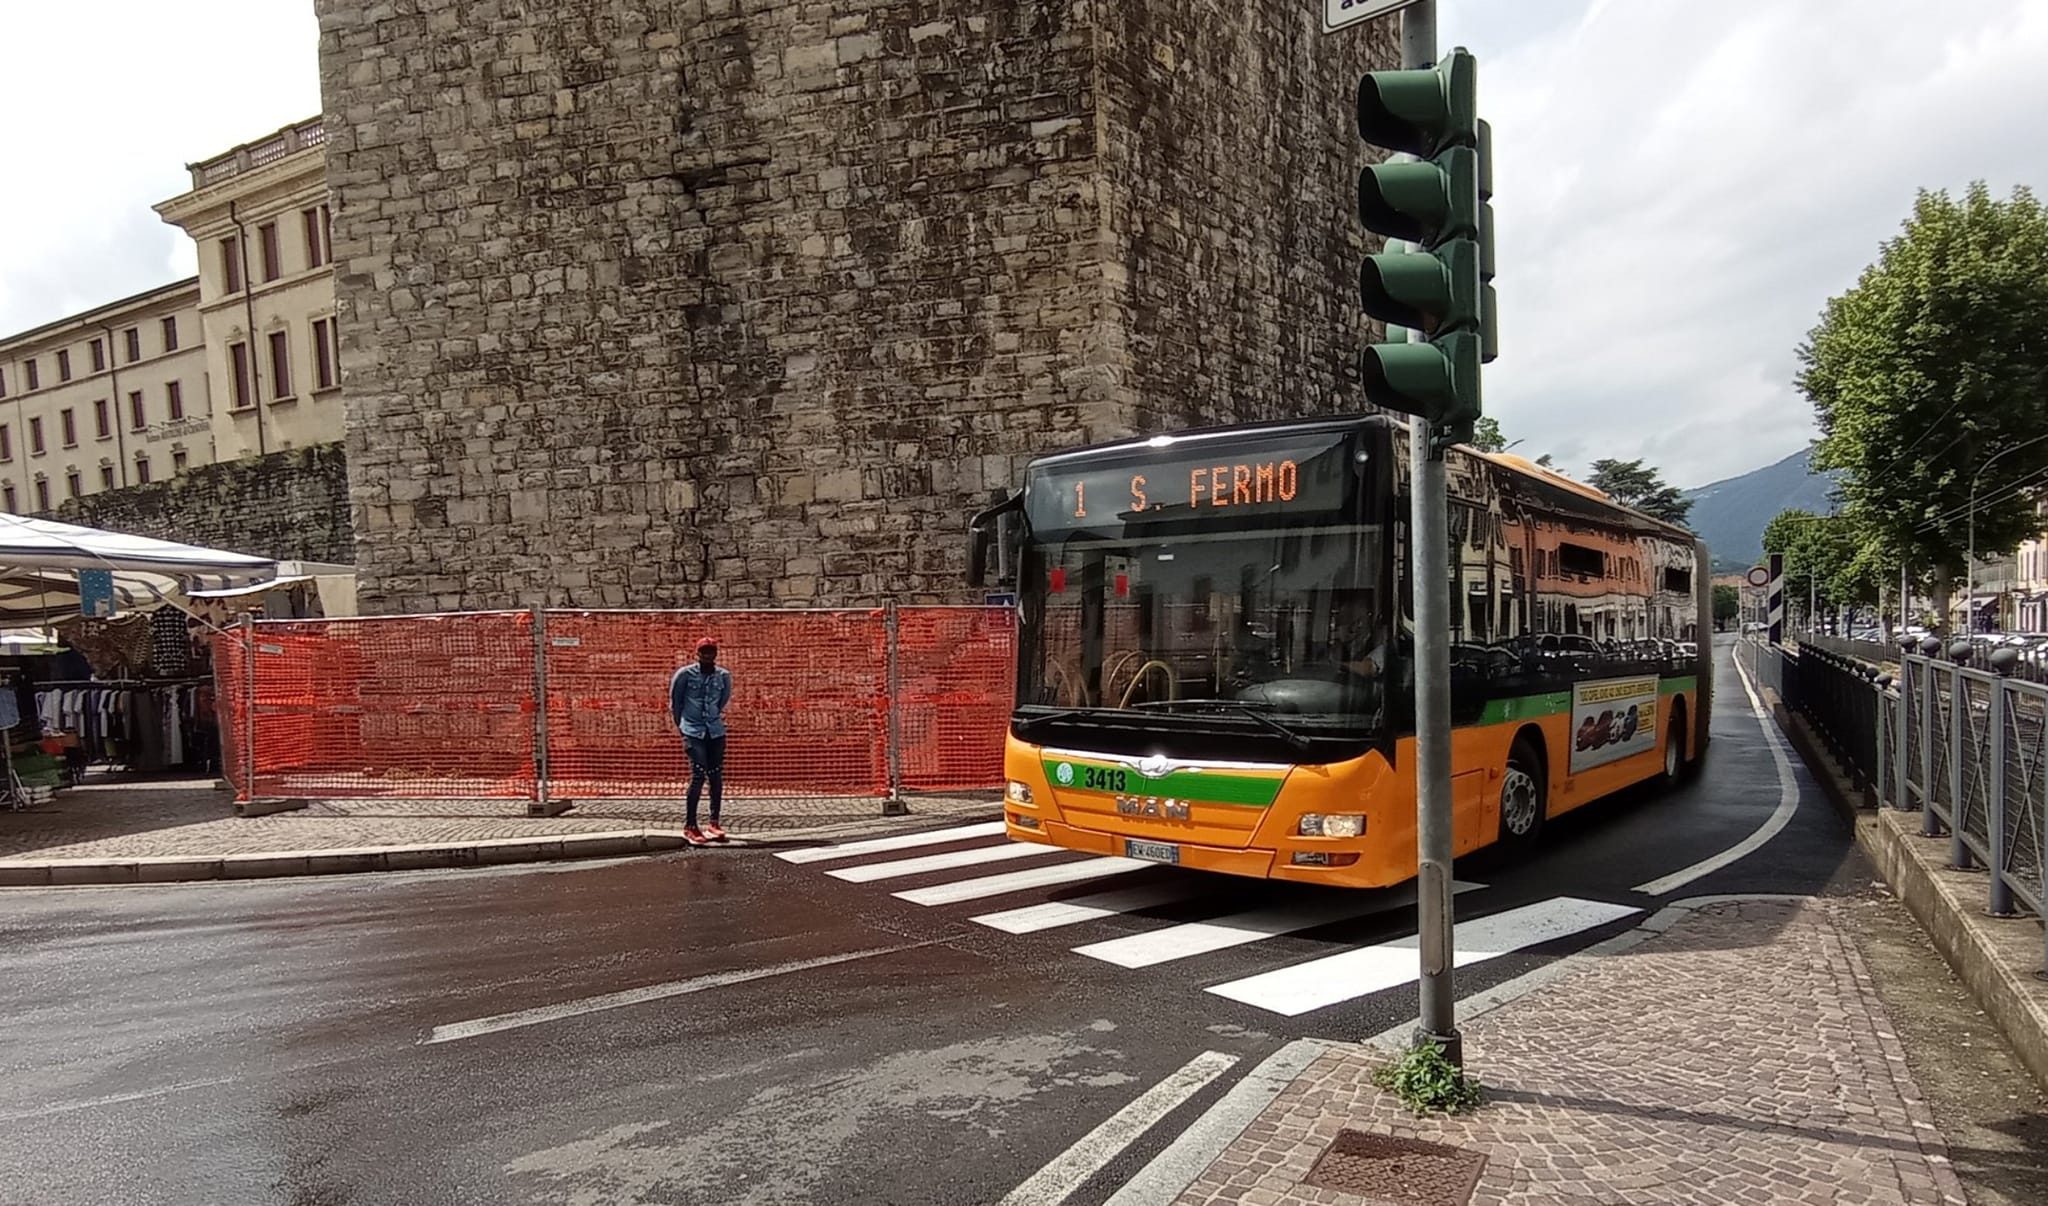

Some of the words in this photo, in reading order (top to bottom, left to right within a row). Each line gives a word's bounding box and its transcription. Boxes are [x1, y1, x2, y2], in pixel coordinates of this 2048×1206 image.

[1074, 480, 1087, 518] 1
[1130, 474, 1162, 512] S.
[1190, 461, 1297, 508] FERMO
[1086, 767, 1125, 791] 3413
[1116, 796, 1189, 820] MAN
